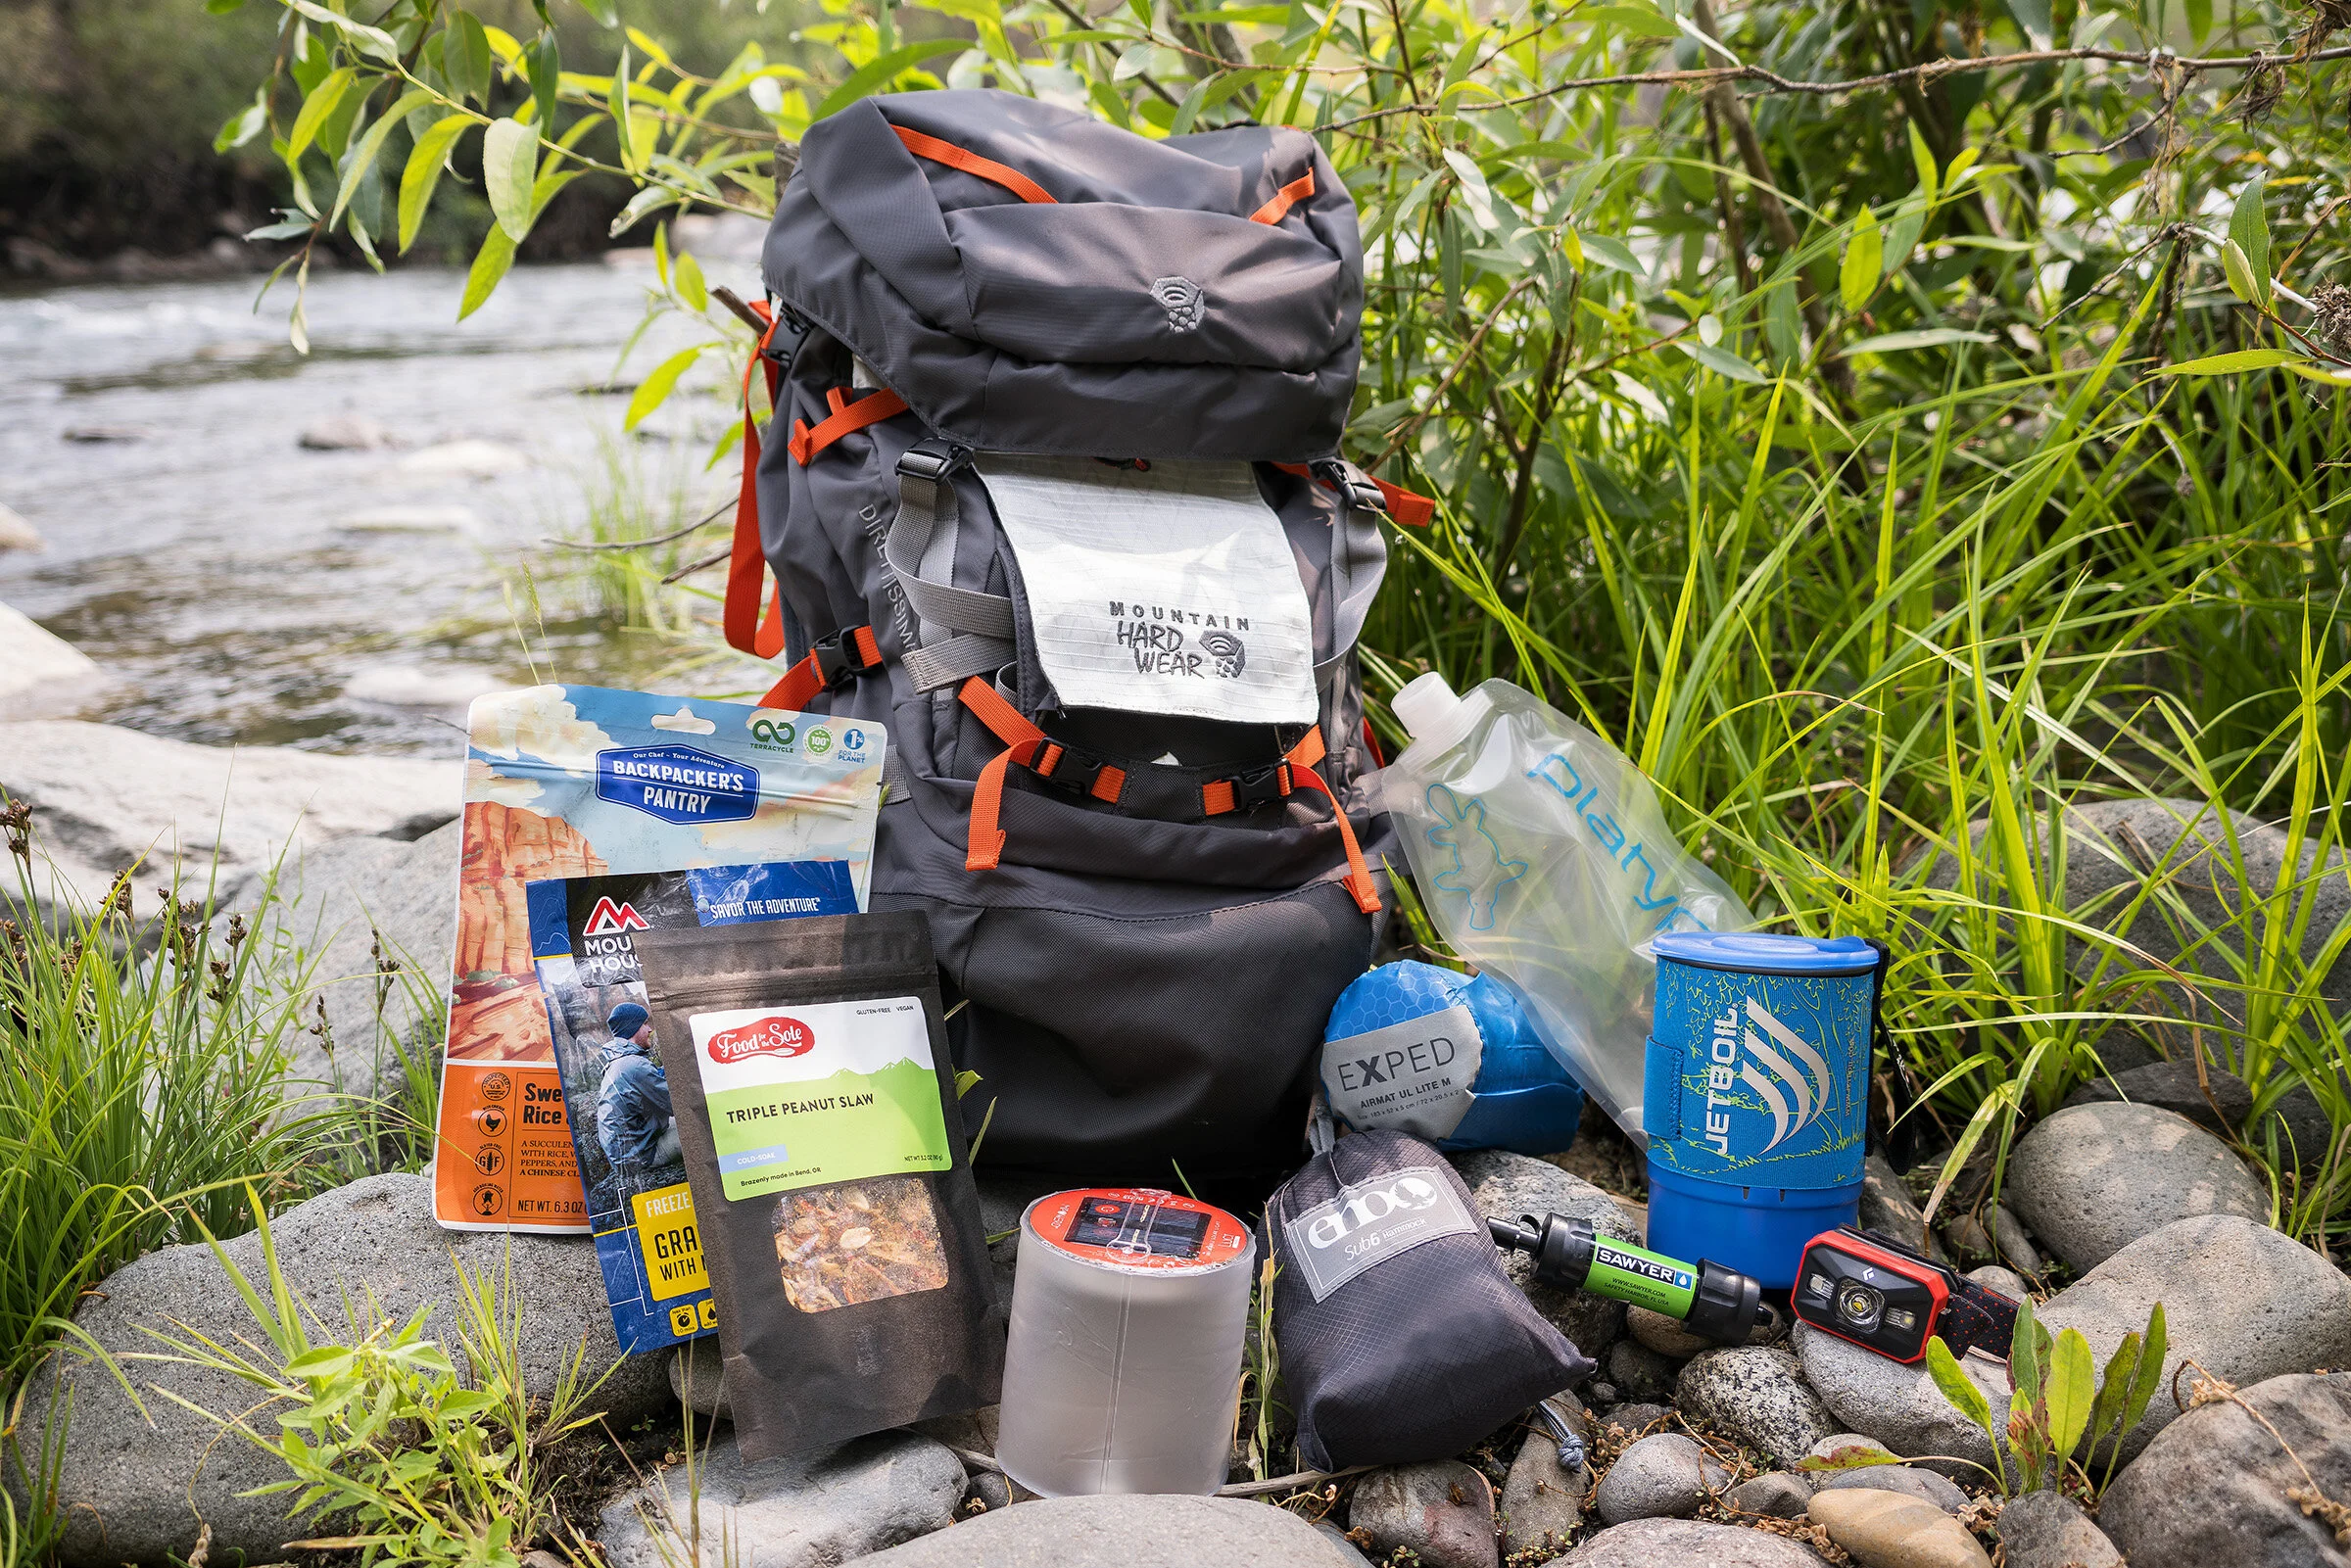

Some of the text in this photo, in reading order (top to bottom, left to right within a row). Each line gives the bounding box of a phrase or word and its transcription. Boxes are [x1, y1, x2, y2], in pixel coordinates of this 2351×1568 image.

[1109, 600, 1250, 631] MOUNTAIN
[1117, 620, 1184, 652] HARD
[1134, 647, 1205, 679] WEAR
[750, 742, 794, 753] TERRACYCLE
[838, 754, 866, 764] PLANET
[690, 755, 725, 769] Adventure
[612, 760, 744, 792] BACKPACKER'S
[644, 785, 712, 814] PANTRY
[709, 901, 745, 920] SAVOR
[744, 900, 766, 916] THE
[855, 1007, 891, 1016] GLUTEN-FREE
[716, 1032, 760, 1059] Food
[768, 1022, 803, 1048] Sole
[1336, 1036, 1456, 1093] EXPED
[524, 1082, 564, 1103] Swe
[1361, 1077, 1452, 1109] AIRMAT UL LITE M
[1704, 1004, 1739, 1156] JETBOIL
[523, 1105, 562, 1125] Rice
[726, 1093, 875, 1123] TRIPLE PEANUT SLAW
[547, 1150, 569, 1159] RICE,
[741, 1175, 769, 1186] Brazenly
[770, 1172, 788, 1181] made
[794, 1167, 811, 1176] Bend,
[518, 1200, 583, 1213] NET WT. 6.3 OZ
[646, 1191, 691, 1218] FREEZE
[1344, 1217, 1427, 1260] Sub6 Hammock
[659, 1257, 696, 1282] WITH
[1599, 1249, 1674, 1282] SAWYER
[1604, 1282, 1625, 1293] SAFETY
[1656, 1298, 1669, 1307] USA
[1612, 1277, 1666, 1299] WWW.SAWYER.COM
